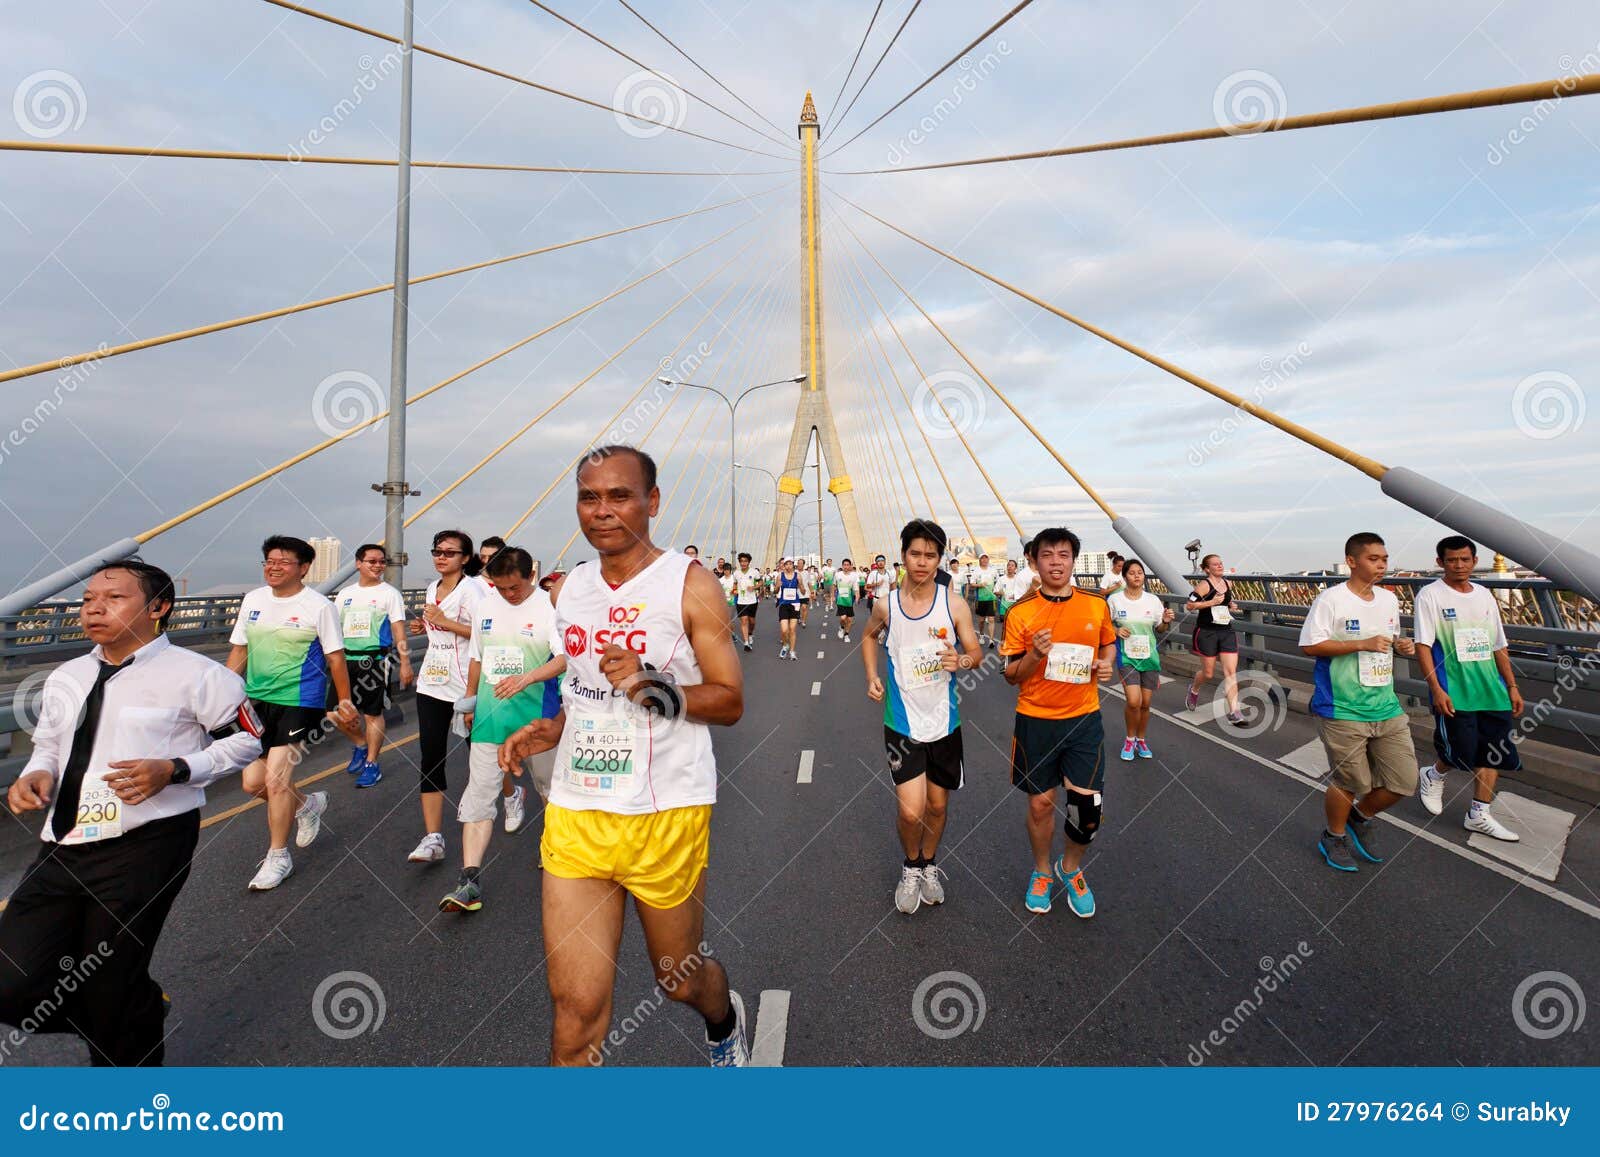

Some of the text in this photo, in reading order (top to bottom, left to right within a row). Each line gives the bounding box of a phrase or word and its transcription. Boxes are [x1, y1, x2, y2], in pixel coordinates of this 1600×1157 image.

[494, 663, 523, 675] 20696
[1061, 661, 1089, 676] 11724
[574, 747, 632, 772] 22387
